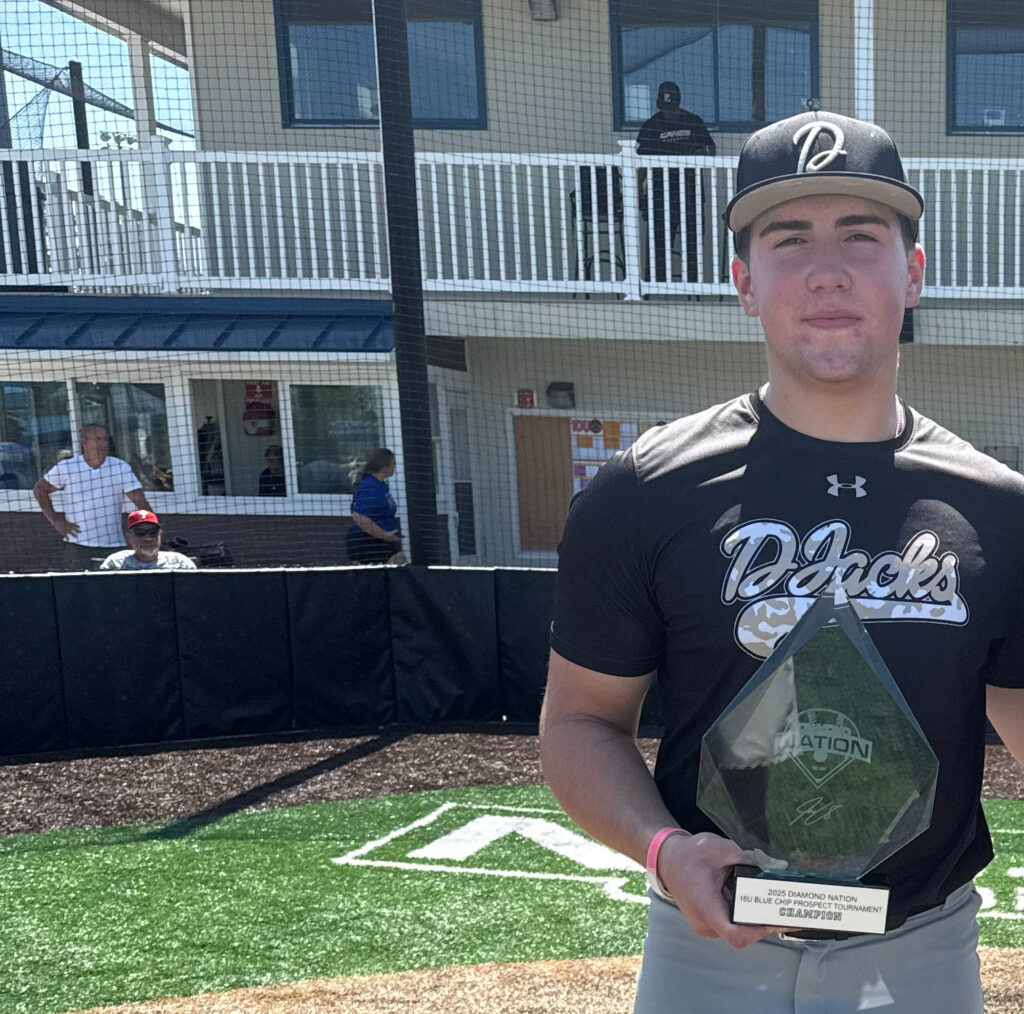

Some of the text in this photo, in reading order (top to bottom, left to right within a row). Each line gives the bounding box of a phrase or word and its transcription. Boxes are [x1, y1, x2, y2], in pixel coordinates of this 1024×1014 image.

[785, 734, 869, 759] ATION
[768, 889, 858, 903] 2025 DIAMOND NATION
[754, 896, 773, 905] BLUE
[774, 898, 793, 906] CHIP
[793, 899, 832, 910] PROSPECT
[834, 903, 882, 913] TOURNAMENT
[779, 907, 843, 921] CHAMPION
